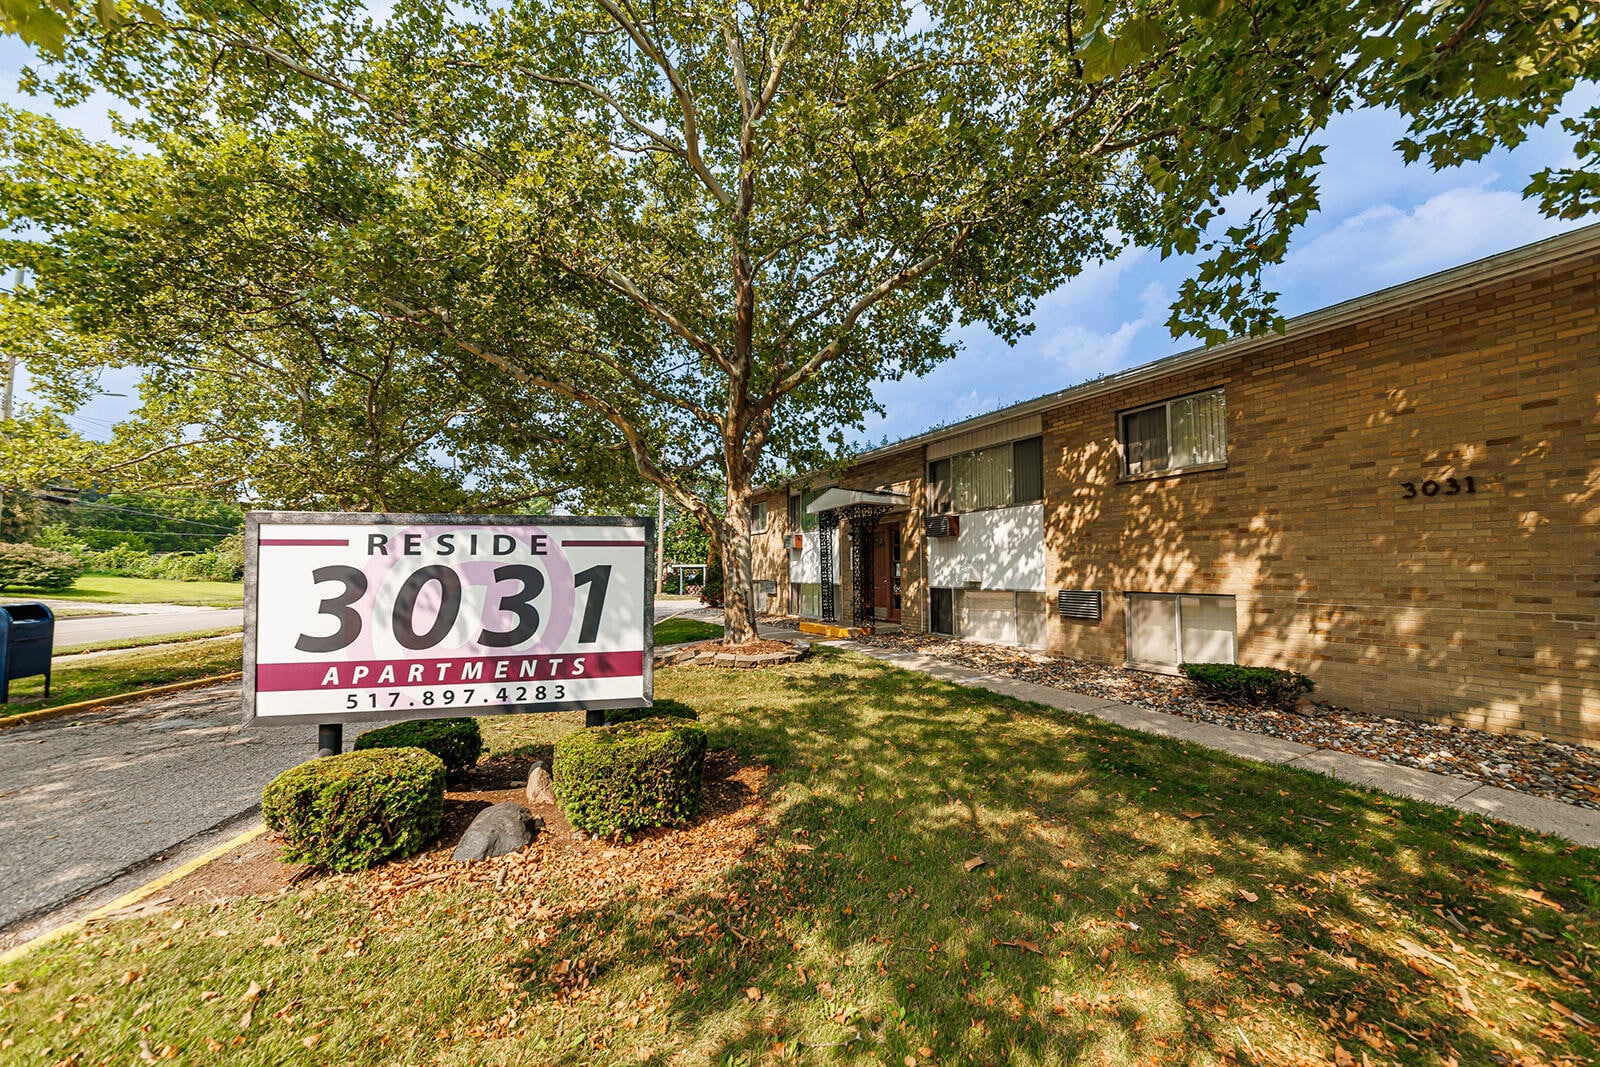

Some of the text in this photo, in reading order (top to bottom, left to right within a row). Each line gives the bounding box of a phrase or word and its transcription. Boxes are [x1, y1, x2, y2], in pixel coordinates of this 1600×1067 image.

[1401, 476, 1476, 499] 3031
[367, 533, 548, 556] RESIDE
[294, 564, 613, 653] 3031
[321, 657, 587, 686] APARTMENTS
[346, 684, 566, 710] 517.897.4283
